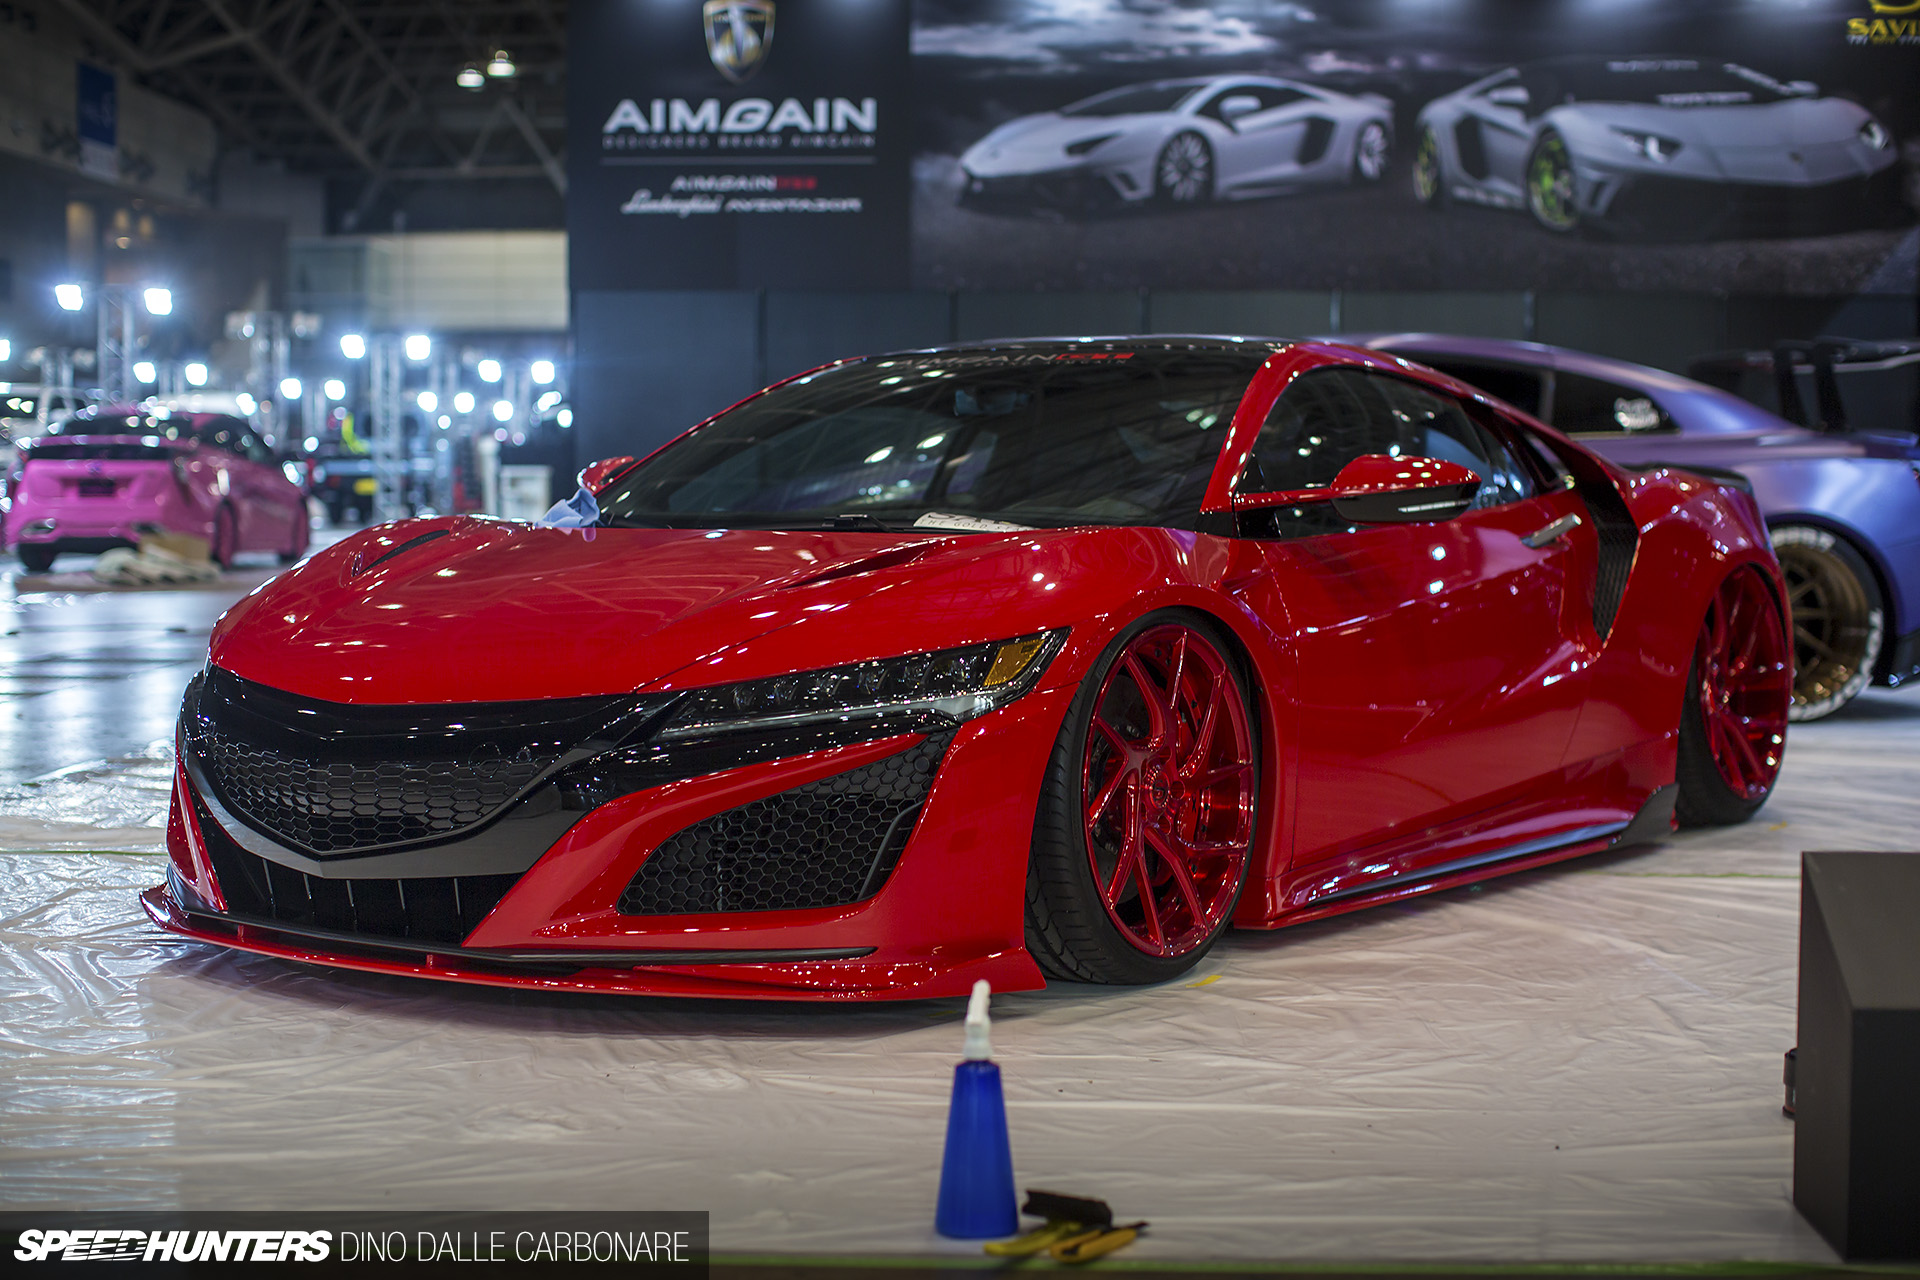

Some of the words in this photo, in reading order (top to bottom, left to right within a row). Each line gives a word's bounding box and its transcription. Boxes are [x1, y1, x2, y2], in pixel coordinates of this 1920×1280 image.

[1847, 18, 1920, 37] SAVI
[603, 98, 877, 133] AIMGAIN
[954, 521, 988, 529] GOLD
